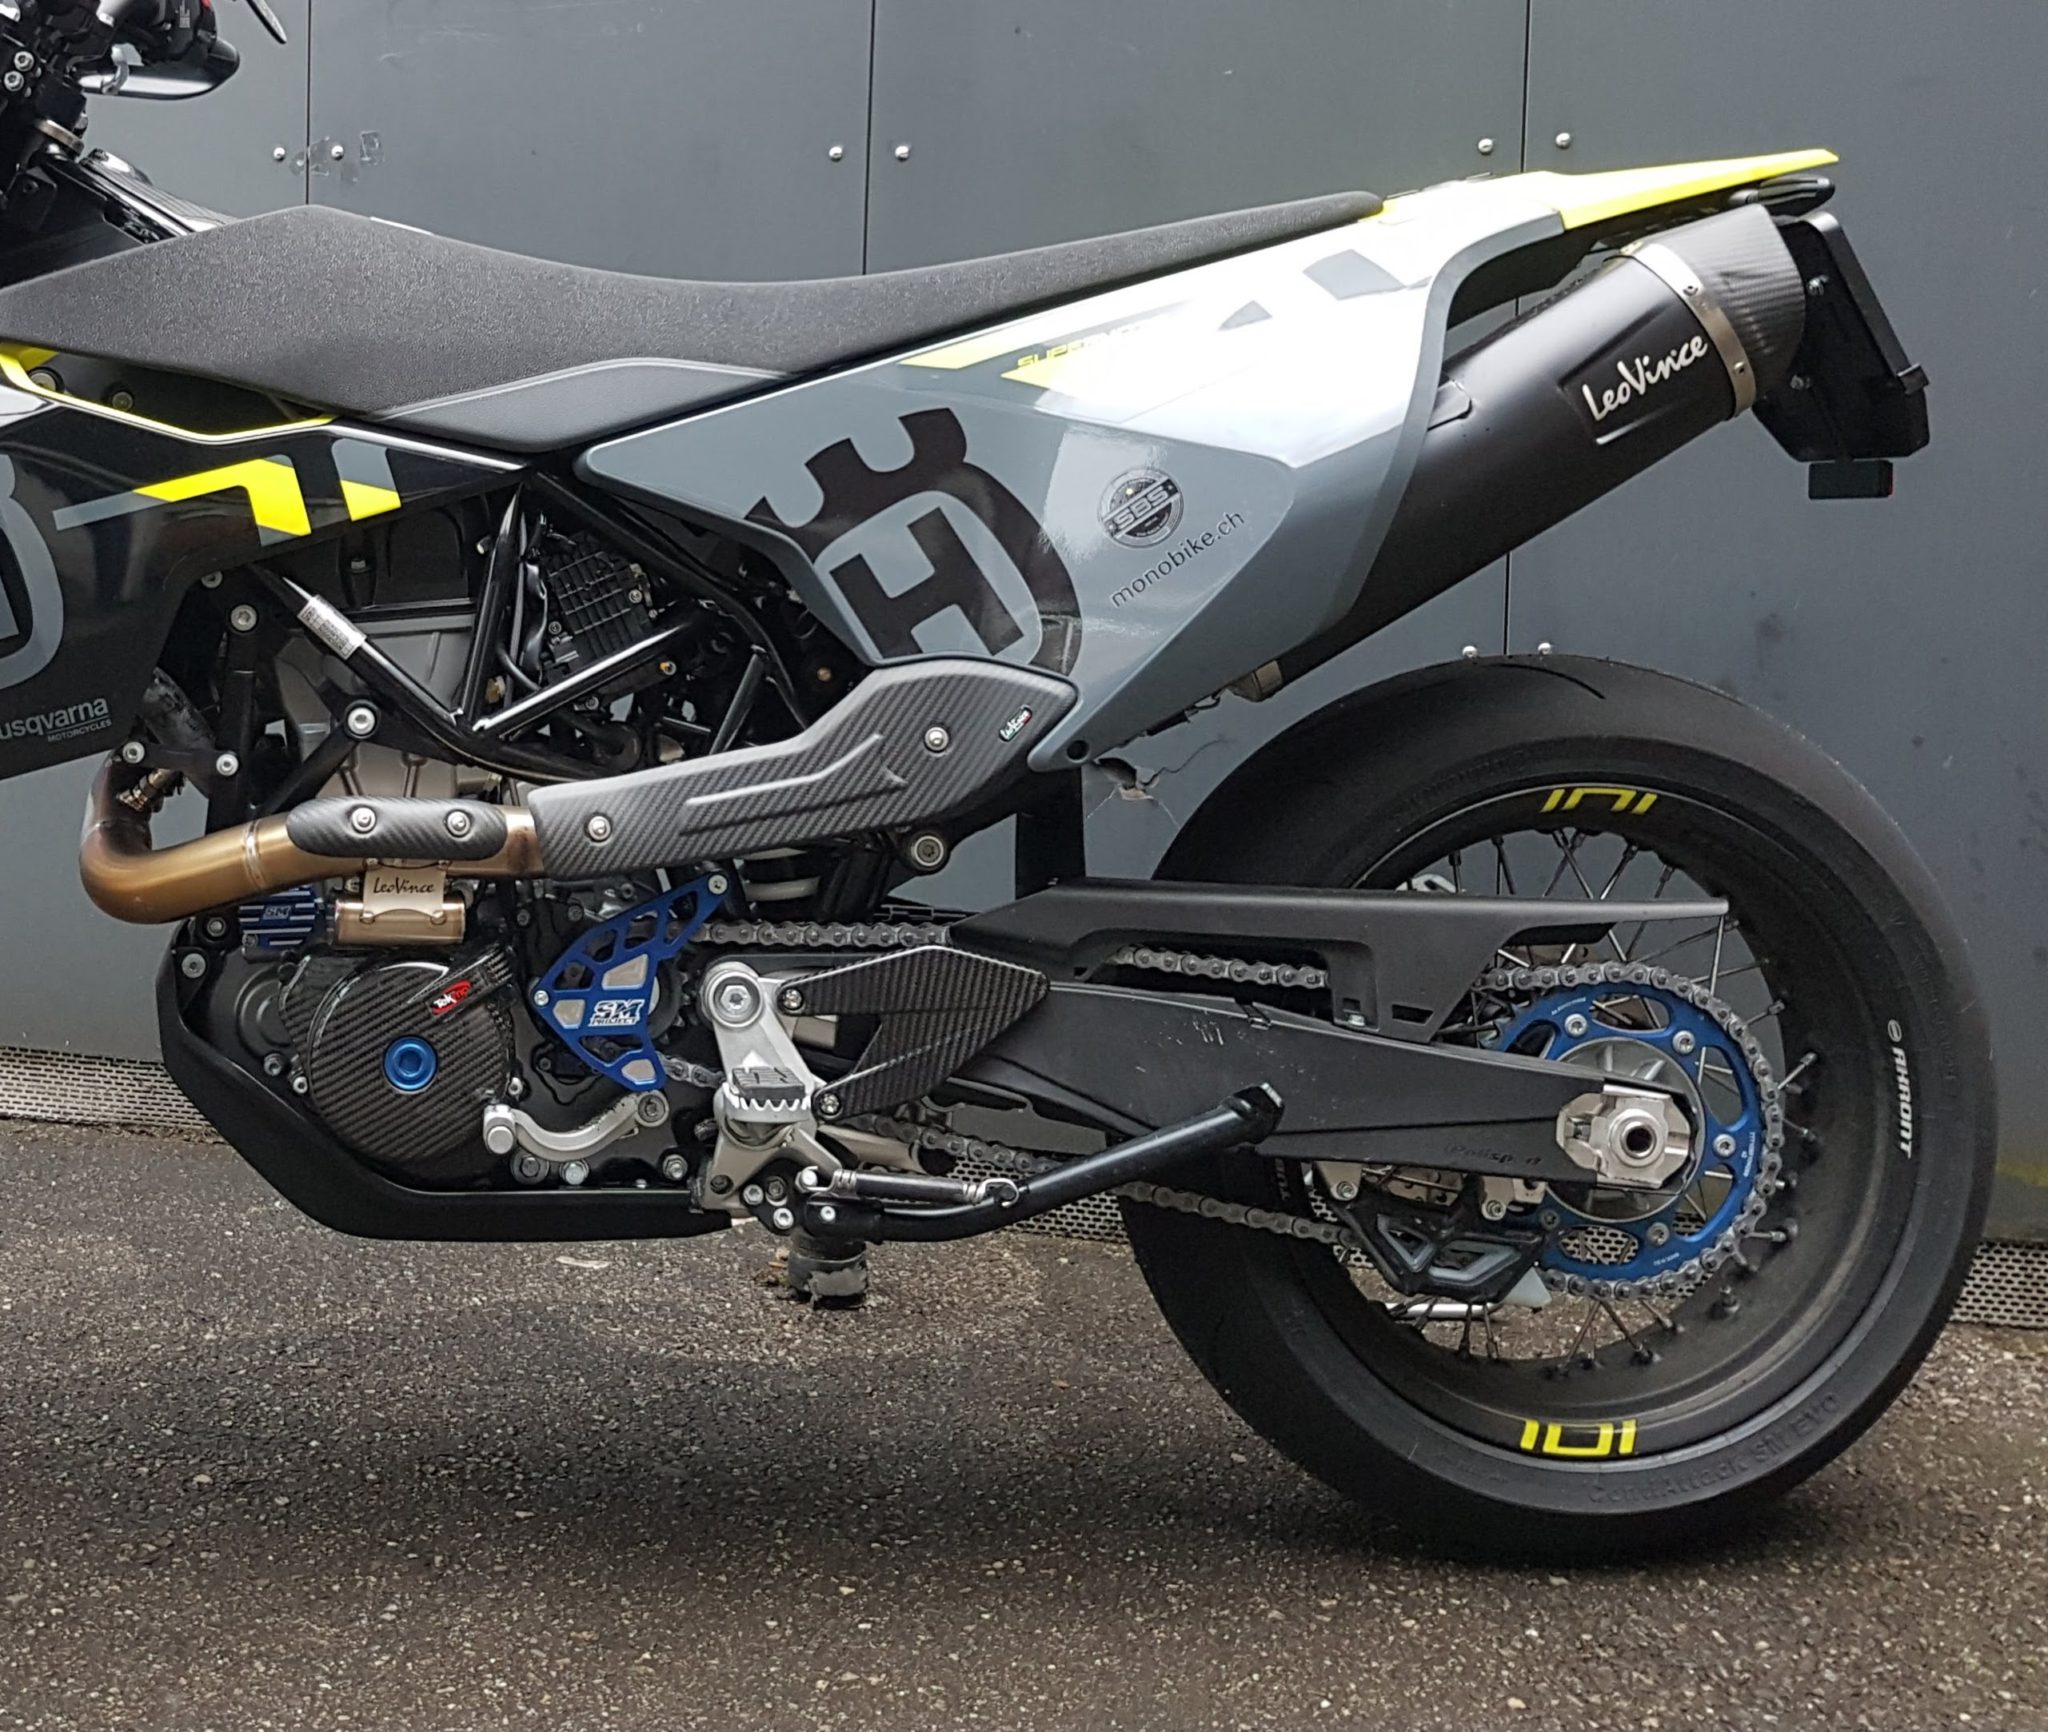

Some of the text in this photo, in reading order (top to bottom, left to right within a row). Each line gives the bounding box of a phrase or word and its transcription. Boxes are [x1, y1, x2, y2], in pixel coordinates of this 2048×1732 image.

[1582, 335, 1708, 421] LeoVince
[1112, 485, 1170, 532] SBS
[1111, 512, 1245, 608] monobike.ch
[0, 698, 109, 740] usqvarna
[47, 719, 112, 742] MOTORCYCLES
[372, 876, 436, 895] LeoVince
[593, 998, 646, 1019] SM
[1891, 1046, 1913, 1159] AKRONT
